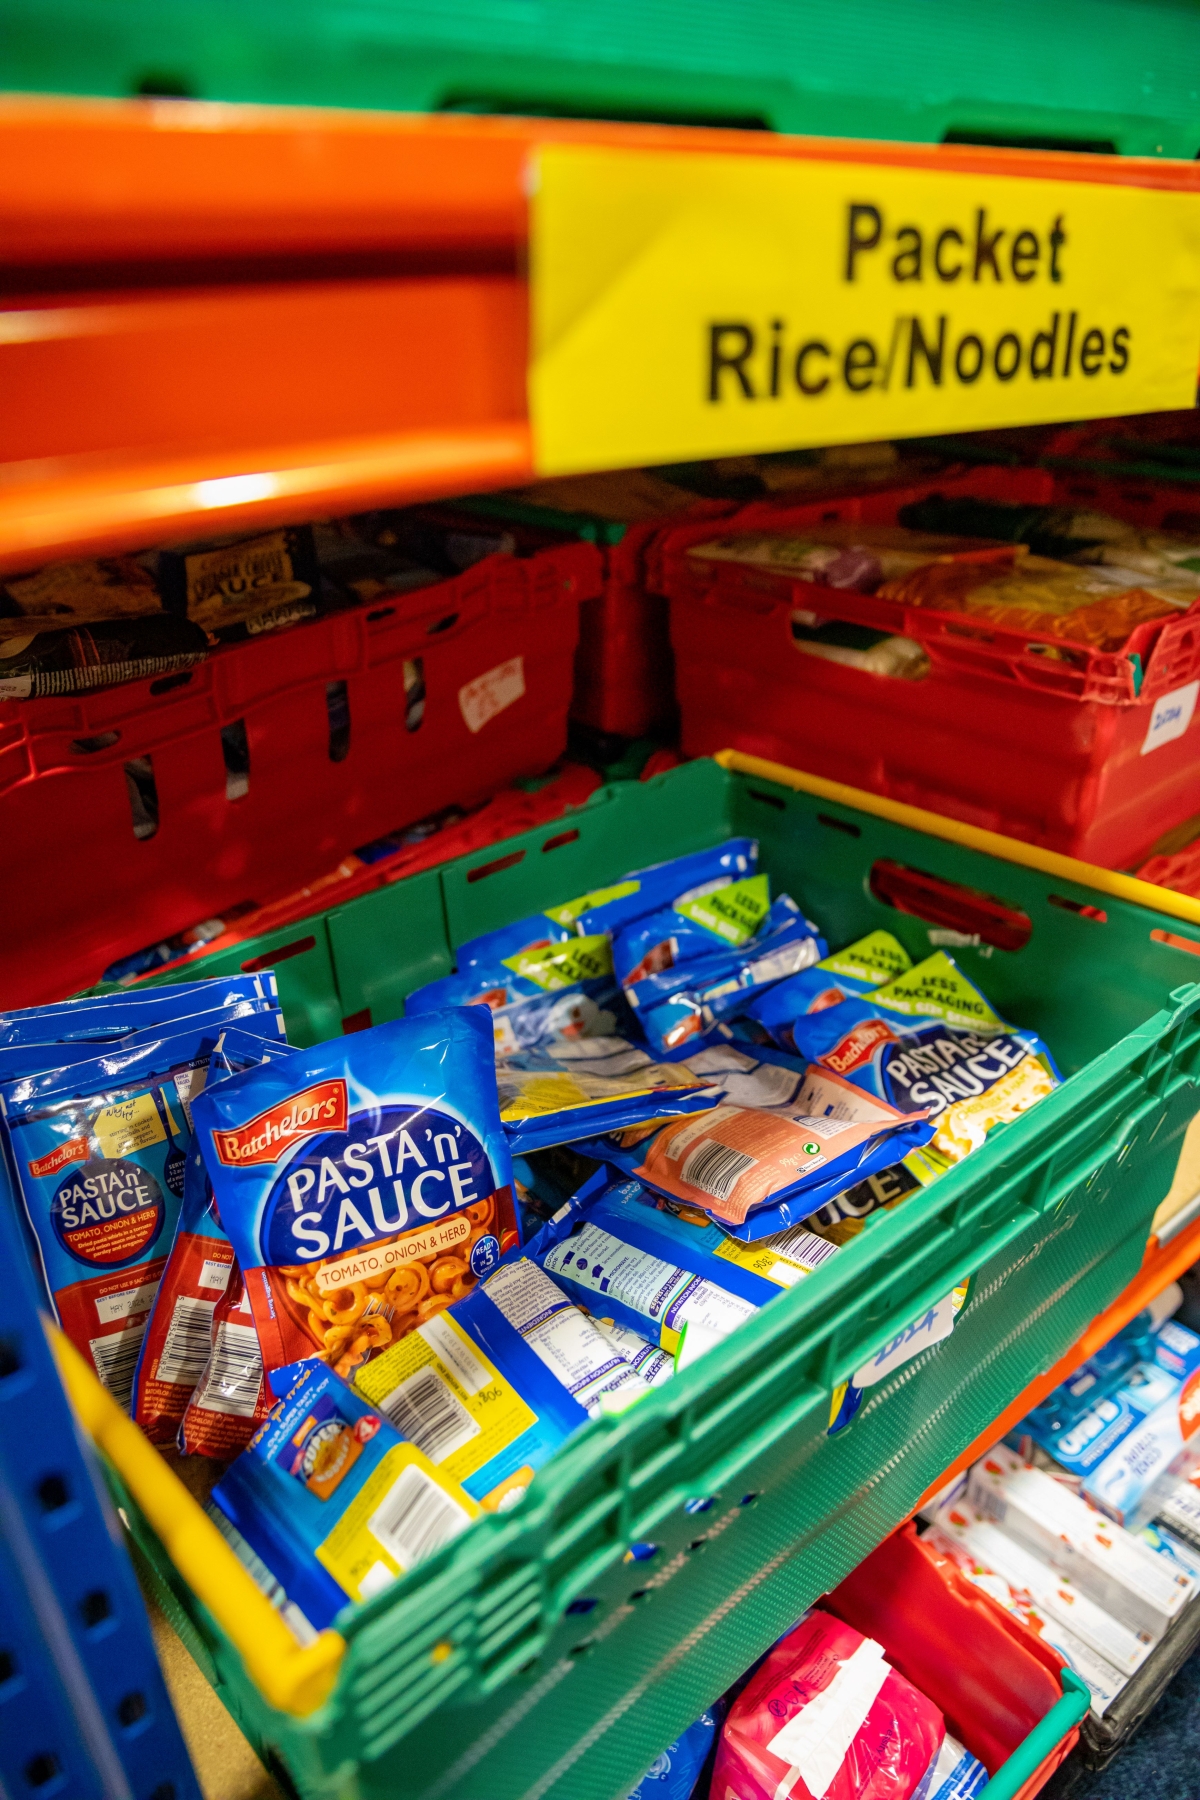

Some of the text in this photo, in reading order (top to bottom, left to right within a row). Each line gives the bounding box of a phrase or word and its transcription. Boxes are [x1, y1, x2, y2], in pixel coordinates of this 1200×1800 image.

[842, 202, 1069, 284] Packet
[706, 310, 1132, 403] Rice/Noodles
[921, 976, 957, 993] LESS
[893, 986, 984, 1015] PACKAGING
[886, 1038, 958, 1087] PASTA
[910, 1039, 1025, 1116] SAUCE
[106, 1106, 122, 1118] Why
[222, 1094, 338, 1162] Batchelors
[31, 1143, 85, 1176] Batchelors
[287, 1129, 419, 1212] PASTA
[778, 1152, 798, 1171] 99g
[58, 1171, 124, 1209] PASTA
[61, 1185, 152, 1228] SAUCE
[291, 1162, 478, 1259] SAUCE
[104, 1220, 130, 1233] ONION
[137, 1210, 156, 1222] HERB
[78, 1240, 93, 1249] Dried
[321, 1223, 467, 1285] TOMATO, ONION & HERB
[475, 1240, 494, 1256] READY
[485, 1249, 494, 1265] 5
[752, 1255, 773, 1270] 90g
[778, 1255, 792, 1265] BEST
[670, 1288, 691, 1315] NUTRITION
[515, 1308, 554, 1334] INGREDIENTS
[588, 1356, 622, 1380] NUTRITION
[314, 1375, 331, 1394] POT
[478, 1386, 503, 1404] 90g
[265, 1383, 315, 1449] OUR SUPER TASTY
[268, 1400, 291, 1425] you
